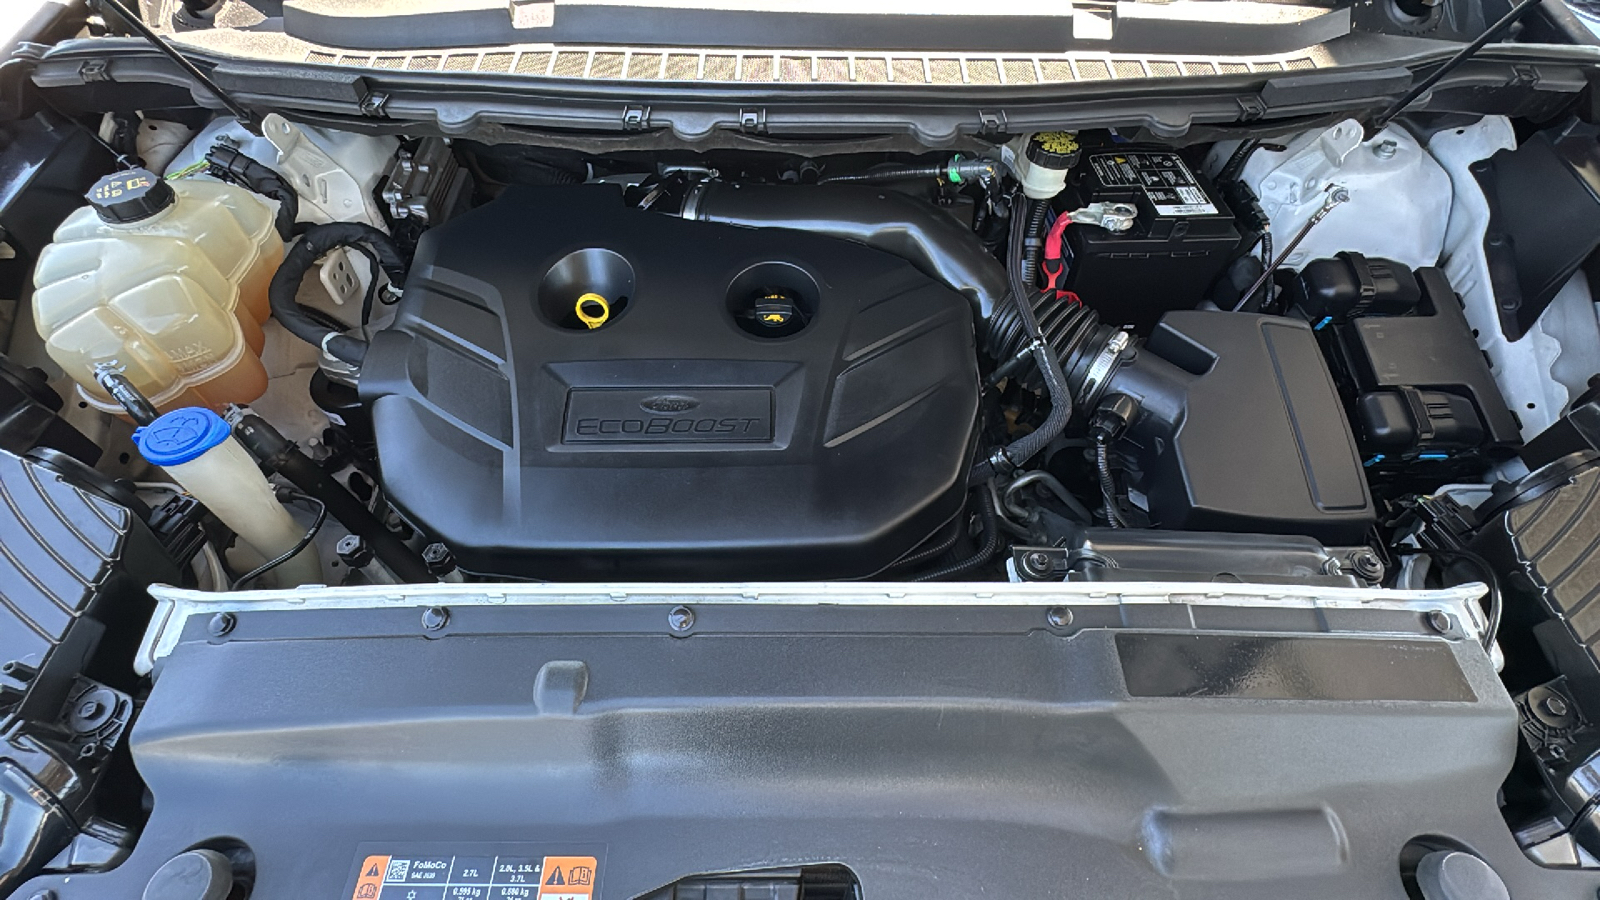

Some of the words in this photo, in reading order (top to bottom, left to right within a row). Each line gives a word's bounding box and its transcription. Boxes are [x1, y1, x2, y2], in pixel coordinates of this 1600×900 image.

[413, 861, 447, 869] FoMoCo
[518, 864, 533, 873] 3.5L
[471, 887, 481, 897] kg
[520, 887, 529, 897] kg
